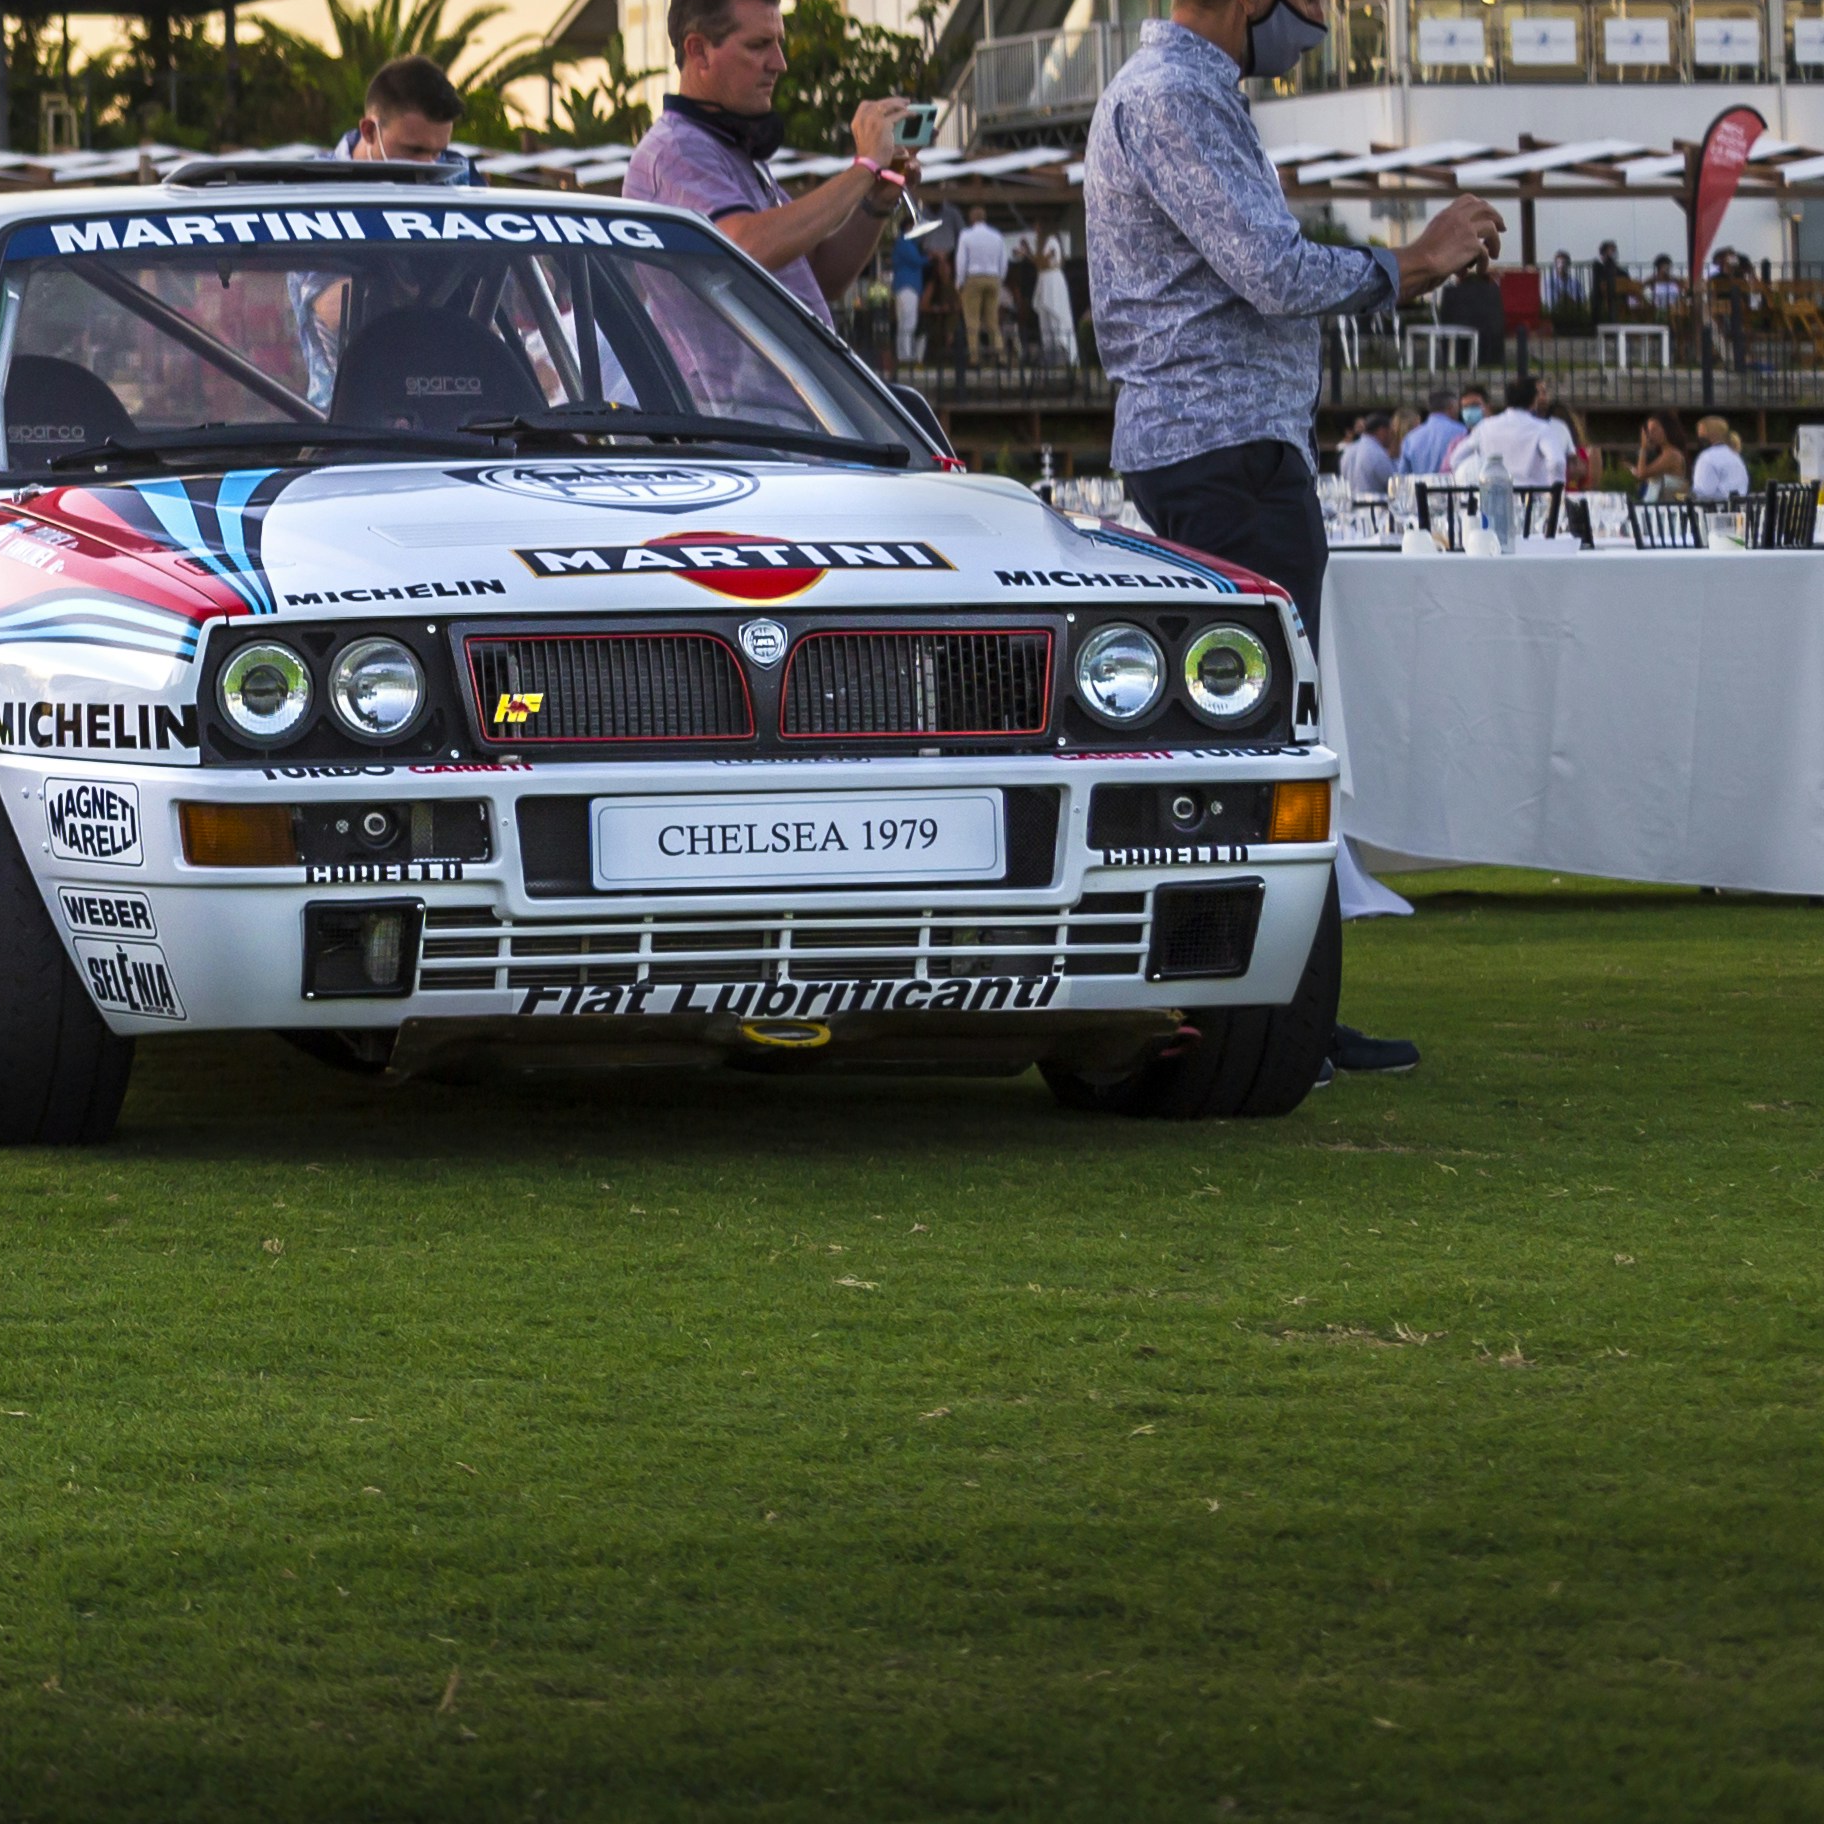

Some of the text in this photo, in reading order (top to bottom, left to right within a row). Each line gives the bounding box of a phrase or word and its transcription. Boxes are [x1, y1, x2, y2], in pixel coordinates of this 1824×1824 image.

[50, 210, 664, 254] MARTINI RACING
[405, 376, 483, 396] sparco
[8, 425, 85, 444] sparco
[533, 543, 933, 573] MARTINI
[284, 578, 508, 607] MICHELIN
[993, 570, 1210, 591] MICHELIN
[494, 692, 544, 723] HF
[49, 785, 137, 833] MAGNETI
[49, 813, 137, 857] MARELLI
[657, 817, 938, 857] CHELSEA 1979
[1104, 844, 1249, 866] CARELLO
[305, 862, 463, 884] CARELLO
[63, 895, 152, 930] WEBER
[670, 969, 1062, 1017] Lubrificanti
